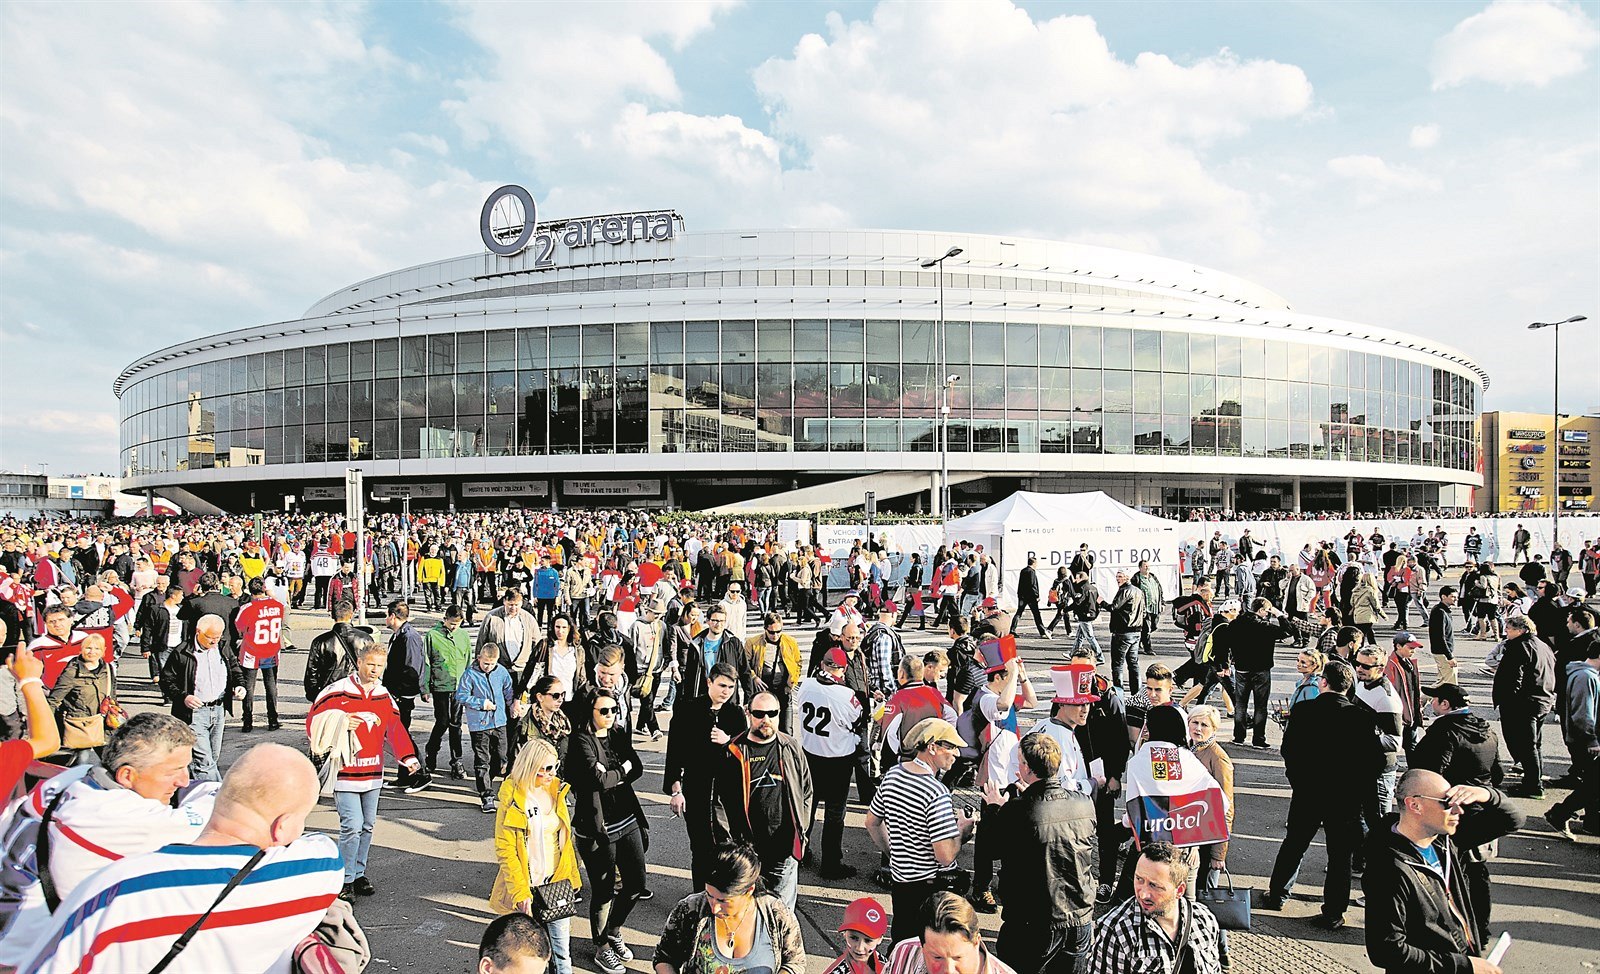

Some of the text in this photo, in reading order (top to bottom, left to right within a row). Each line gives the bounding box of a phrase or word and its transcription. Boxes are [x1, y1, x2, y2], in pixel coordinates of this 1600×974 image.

[563, 213, 674, 248] arena
[1520, 486, 1540, 495] Pure
[316, 557, 329, 568] 48
[1130, 548, 1161, 564] BOX
[258, 605, 280, 618] JÁGR
[253, 617, 282, 645] 68
[802, 701, 832, 738] 22
[1144, 811, 1201, 832] urotel
